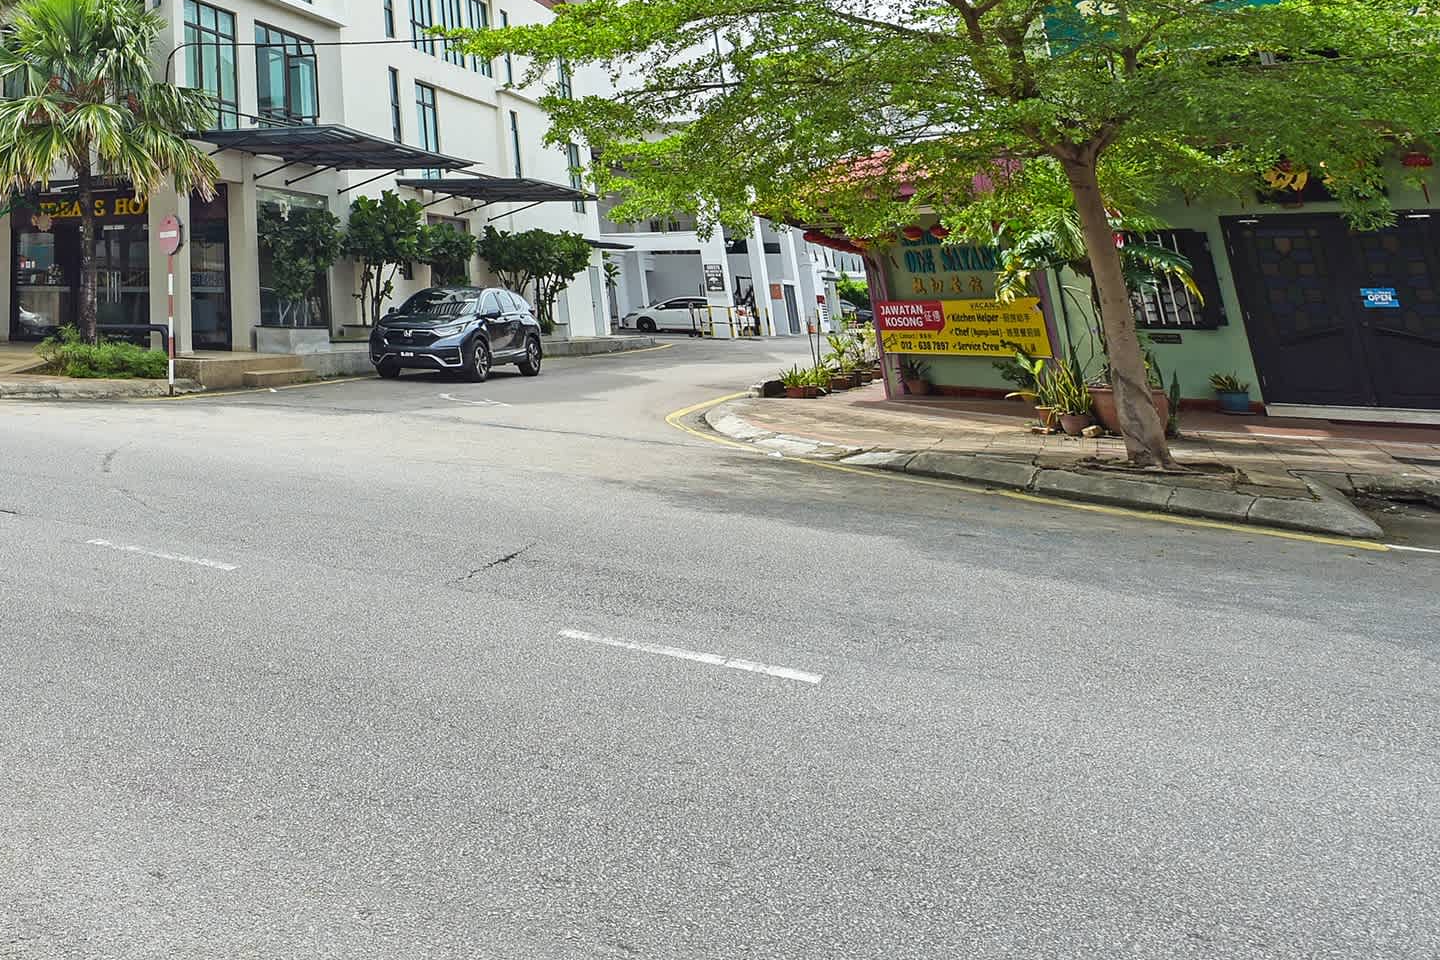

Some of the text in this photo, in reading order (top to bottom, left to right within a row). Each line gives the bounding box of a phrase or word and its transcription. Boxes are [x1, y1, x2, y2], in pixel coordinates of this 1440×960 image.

[879, 304, 924, 316] JAWATAN
[885, 316, 924, 328] KOSONG
[951, 313, 976, 321] Kitchen
[976, 313, 999, 323] Helper
[954, 327, 970, 337] Chef
[900, 341, 913, 350] 012
[958, 342, 981, 351] Service
[982, 342, 1000, 351] Crew
